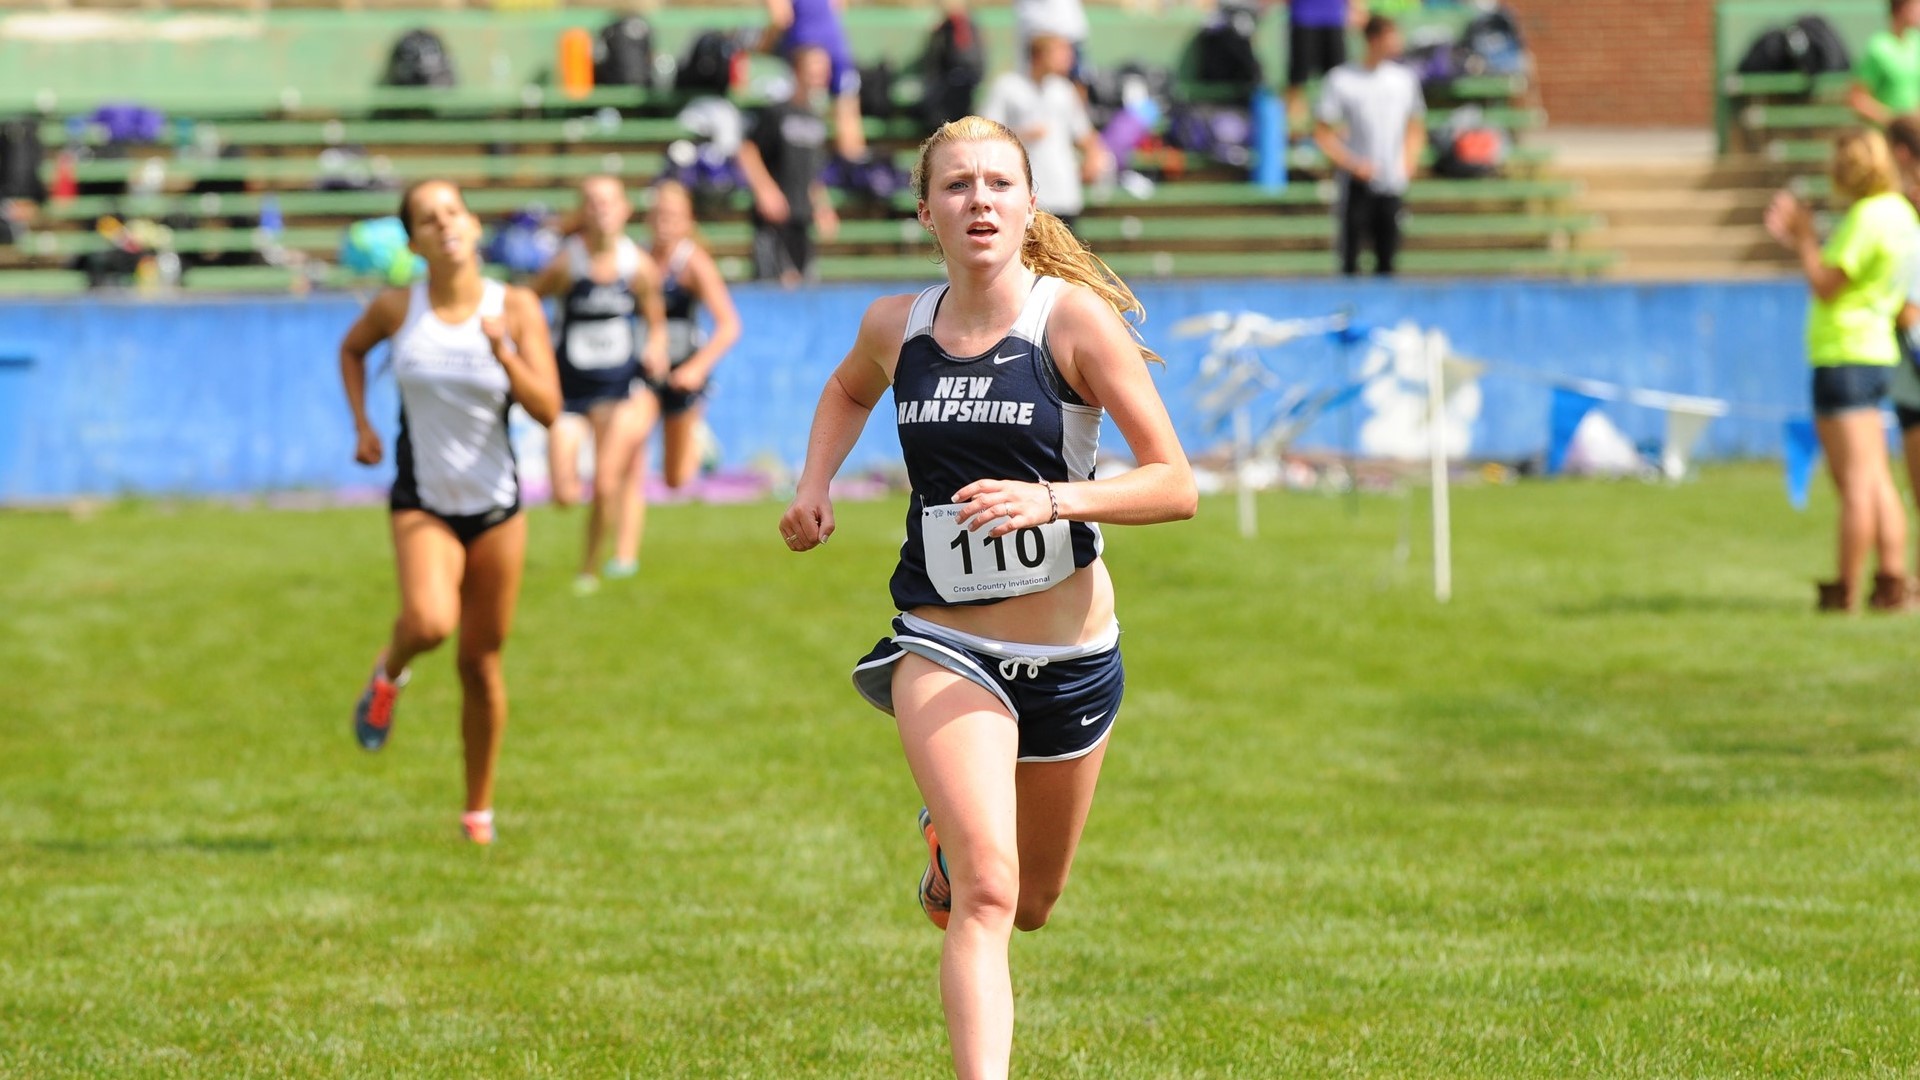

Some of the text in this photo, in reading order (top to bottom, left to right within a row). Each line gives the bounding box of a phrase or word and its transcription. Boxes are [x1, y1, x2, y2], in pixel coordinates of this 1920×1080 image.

[933, 376, 993, 399] NEW
[898, 400, 1035, 425] HAMPSHIRE
[950, 526, 1045, 575] 110
[953, 575, 1050, 593] Cross Country Invitational
